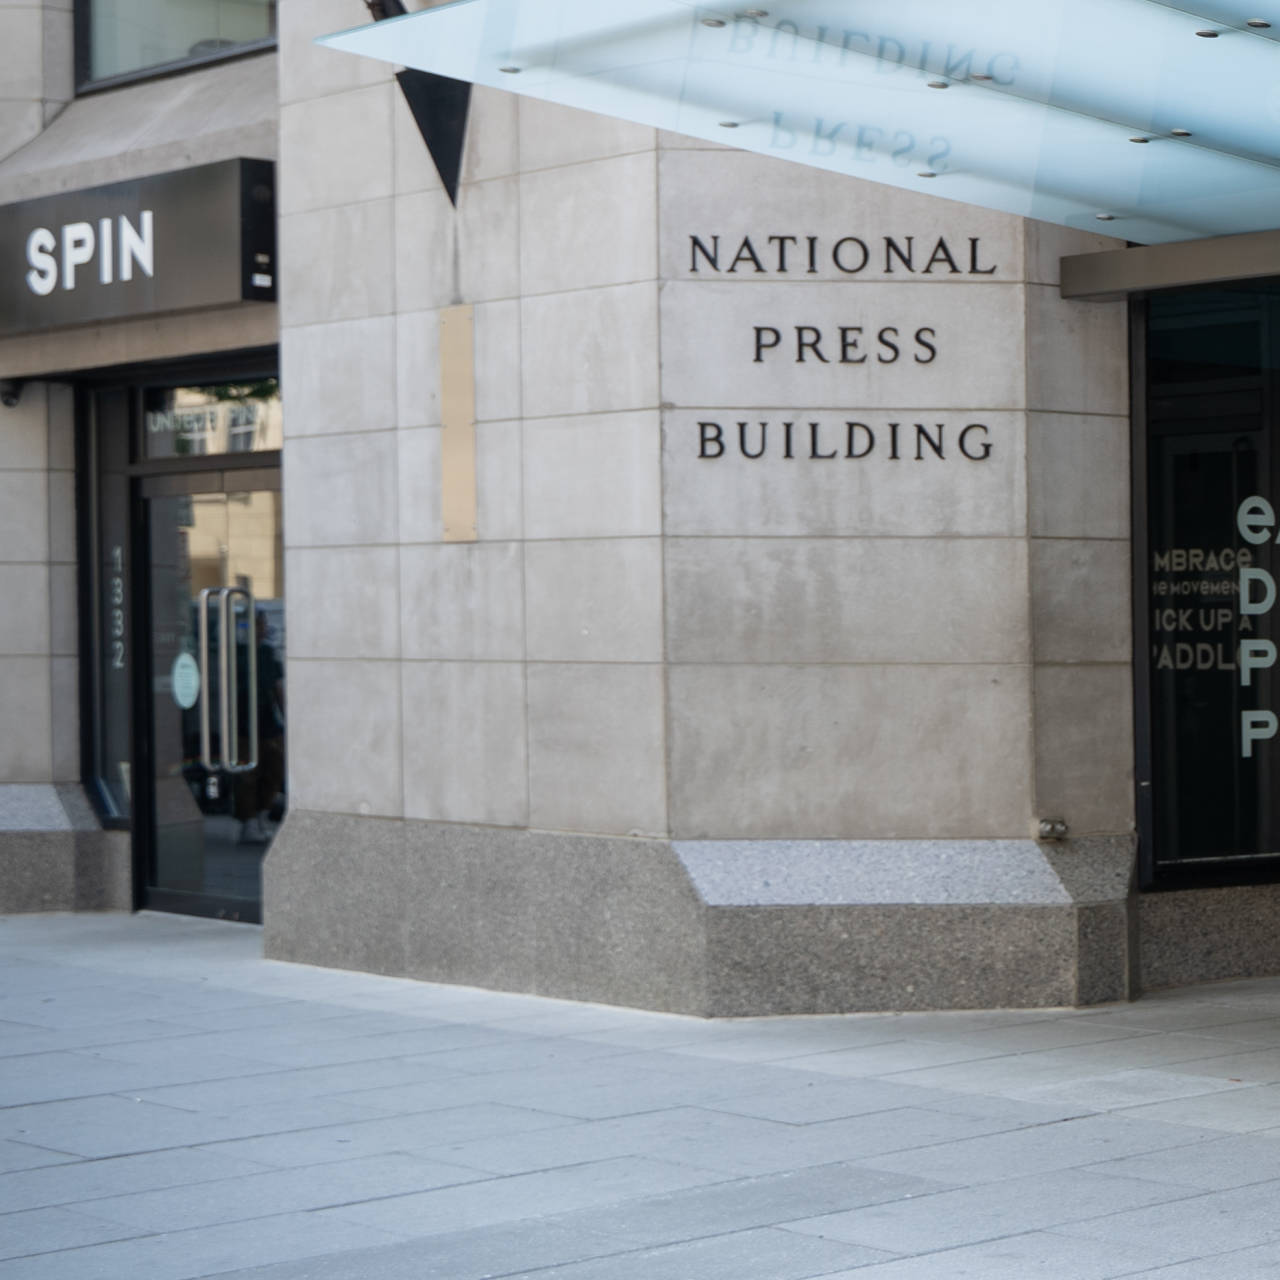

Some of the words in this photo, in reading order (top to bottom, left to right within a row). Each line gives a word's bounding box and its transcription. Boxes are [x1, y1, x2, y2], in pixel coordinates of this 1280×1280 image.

[26, 210, 153, 296] SPIN
[689, 235, 998, 274] NATIONAL
[753, 326, 938, 364] PRESS
[697, 422, 993, 461] BUILDING
[1200, 609, 1233, 631] UP
[1153, 642, 1248, 670] ADDL
